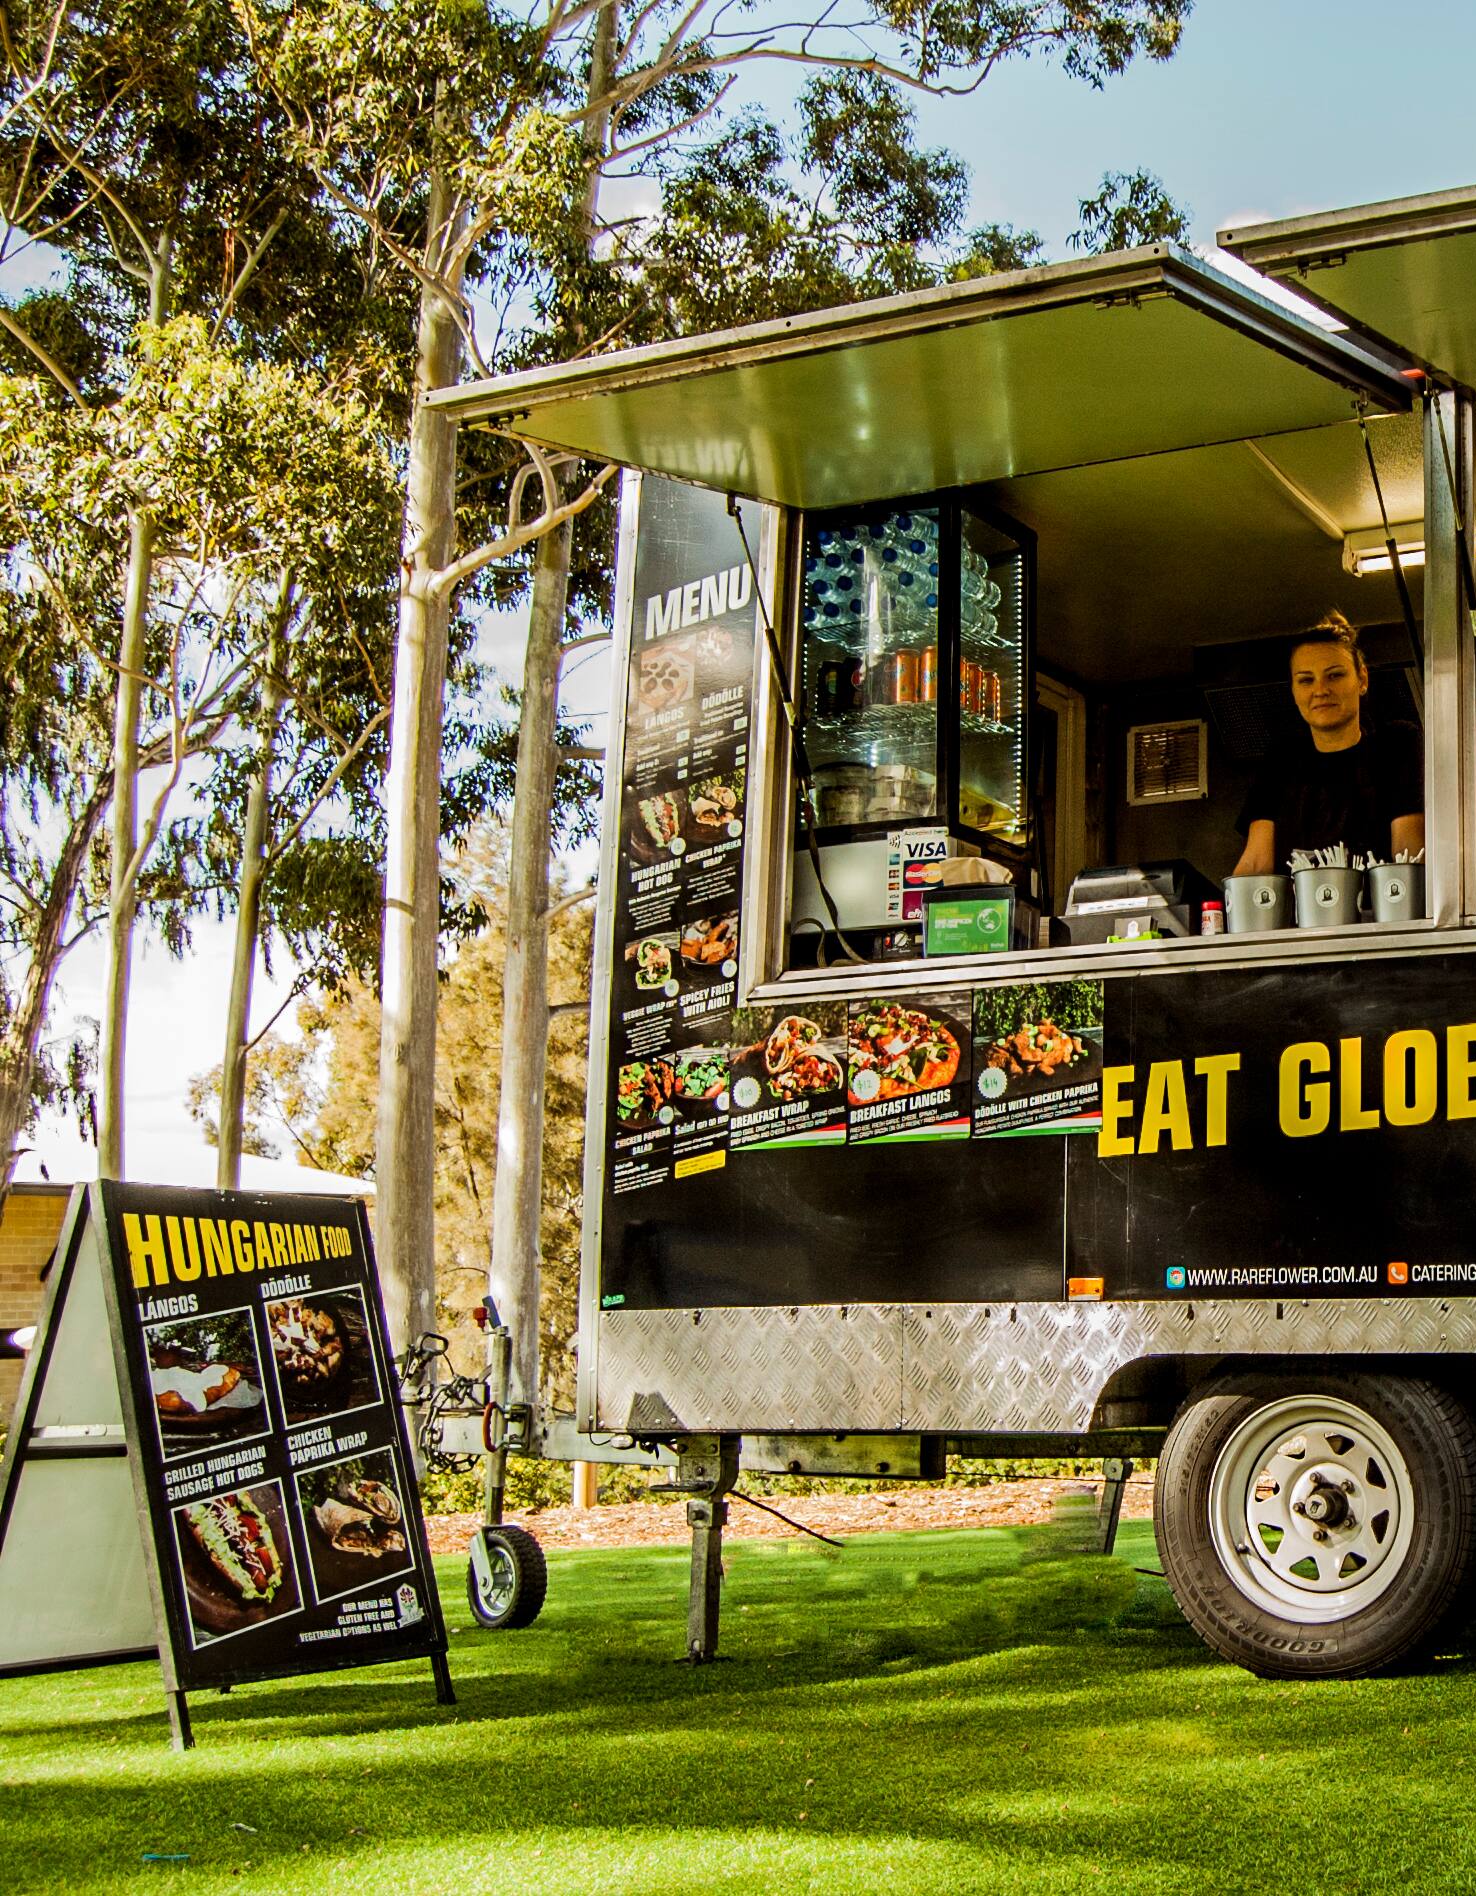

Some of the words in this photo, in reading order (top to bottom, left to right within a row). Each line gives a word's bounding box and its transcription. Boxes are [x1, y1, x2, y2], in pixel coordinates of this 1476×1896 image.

[645, 563, 751, 640] MENU
[906, 842, 946, 857] VISA
[711, 981, 734, 997] FRIES
[683, 1002, 705, 1017] WITH
[707, 995, 730, 1010] AIOLI
[1008, 1098, 1028, 1111] WITH
[1030, 1090, 1063, 1106] CHICKEN
[1064, 1082, 1098, 1099] PAPRIKA
[1097, 1052, 1240, 1157] EAT
[731, 1107, 779, 1130] BREAKFAST
[781, 1100, 809, 1117] WRAP
[850, 1099, 907, 1124] BREAKFAST
[123, 1213, 320, 1289] HUNGARIAN
[321, 1225, 352, 1259] FOOD
[260, 1274, 311, 1298] DÖDÖLLE
[1187, 1266, 1378, 1286] WWW.RAREFLOWER.COM.AU
[139, 1293, 198, 1321] LÁNGOS
[288, 1426, 332, 1450] CHICKEN
[290, 1441, 335, 1465] PAPRIKA
[336, 1432, 367, 1452] WRAP
[165, 1463, 204, 1485] GRILLED
[207, 1446, 266, 1473] HUNGARIAN
[167, 1480, 214, 1501] SAUSAGE
[216, 1472, 236, 1486] HOT
[238, 1462, 264, 1481] DOGS
[338, 1614, 363, 1625] GLUTEN
